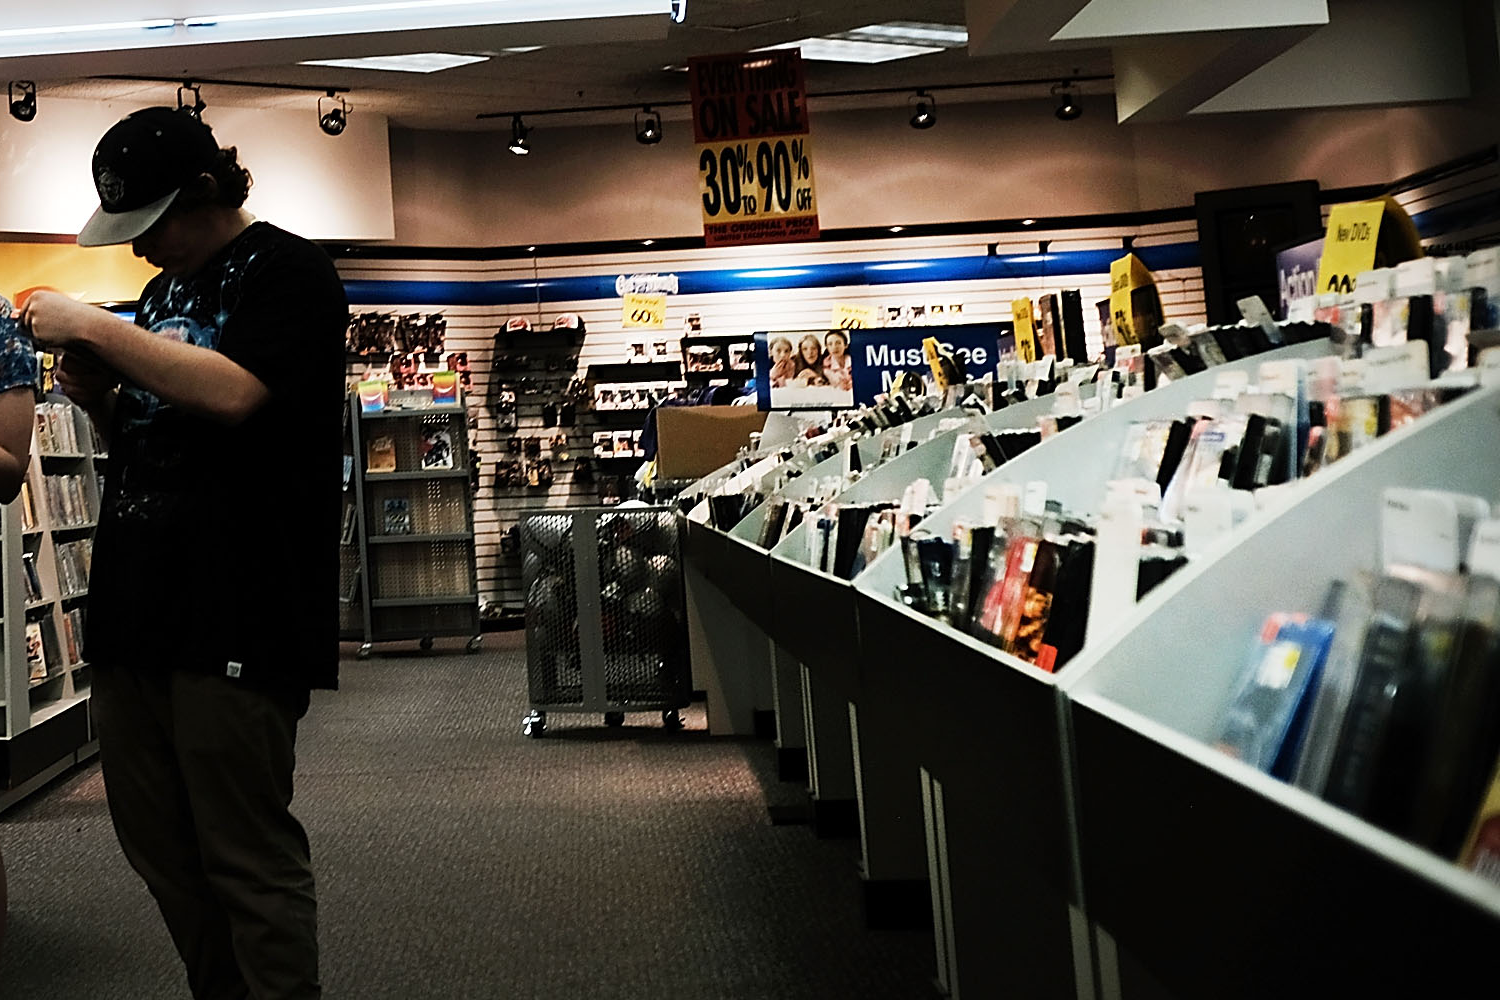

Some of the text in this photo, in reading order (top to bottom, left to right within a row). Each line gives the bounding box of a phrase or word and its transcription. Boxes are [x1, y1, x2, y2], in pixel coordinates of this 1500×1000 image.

[700, 91, 802, 137] ON SALE
[700, 143, 754, 216] 30%
[756, 138, 810, 212] 90%
[796, 188, 812, 211] OFF
